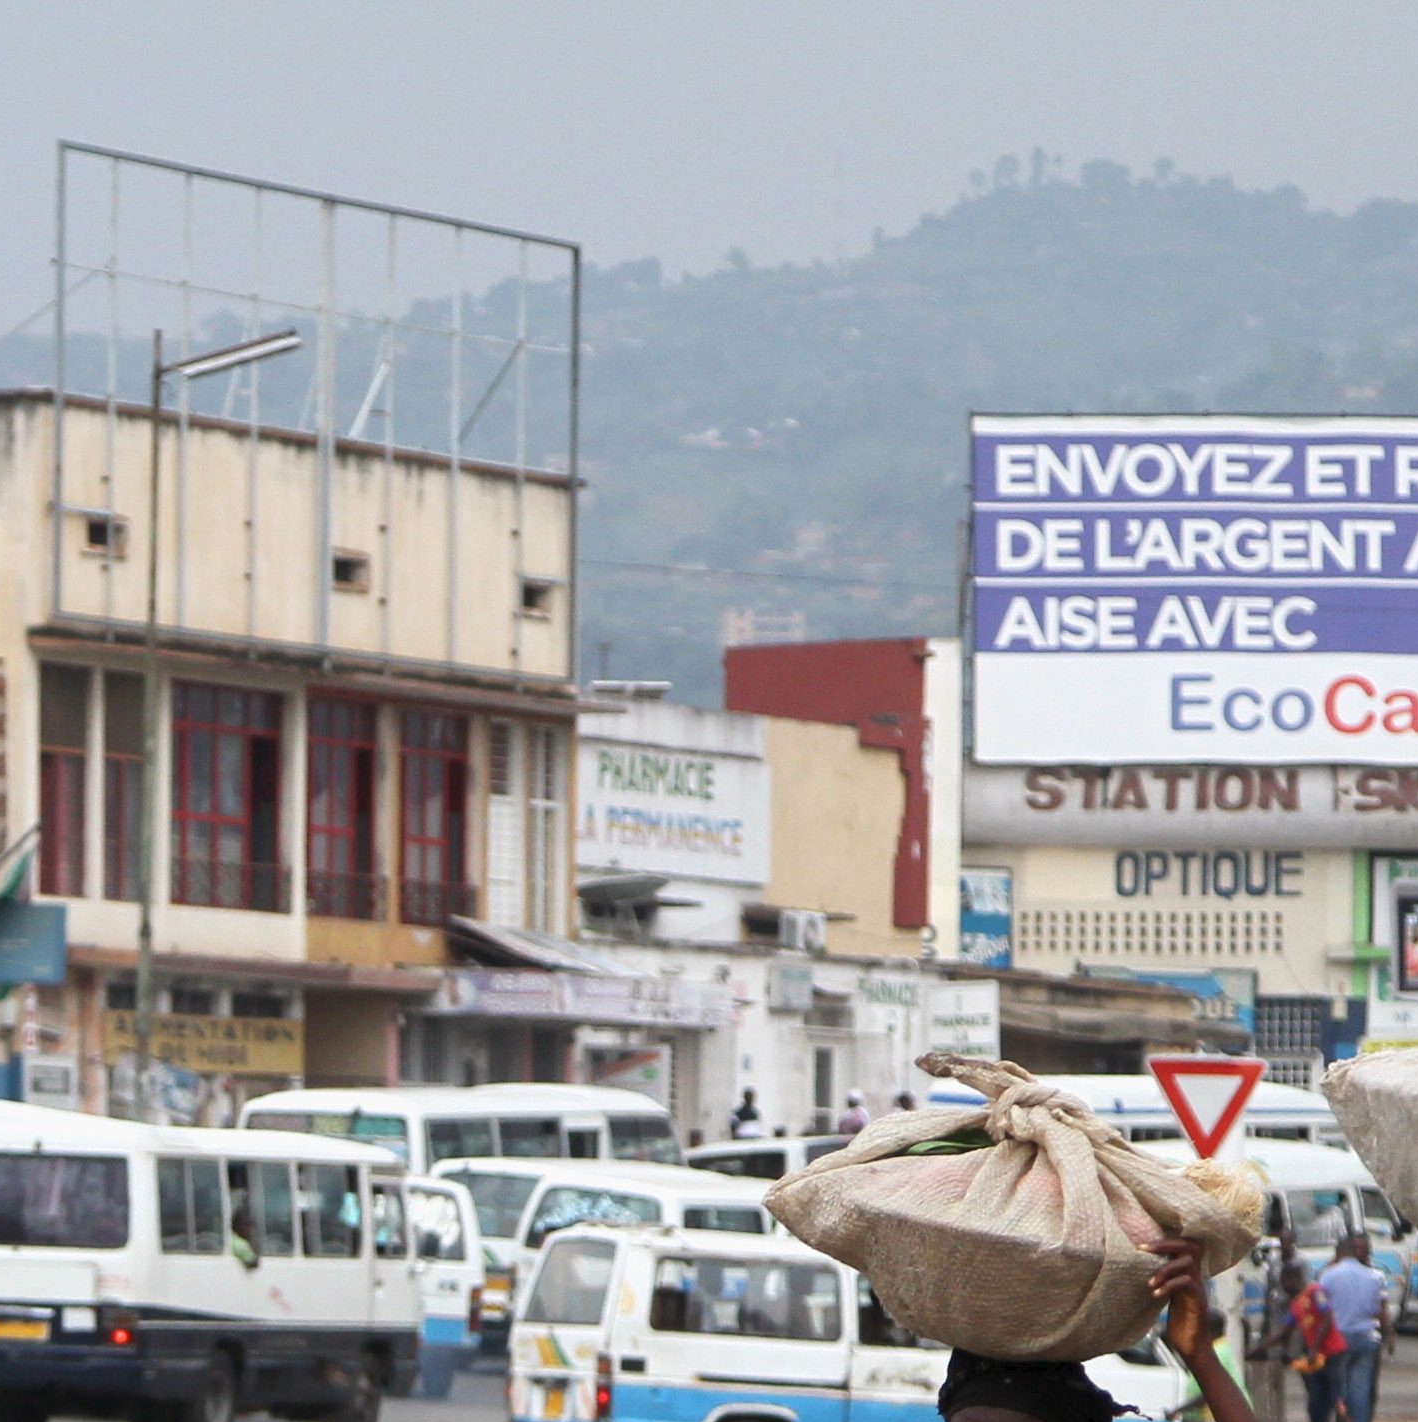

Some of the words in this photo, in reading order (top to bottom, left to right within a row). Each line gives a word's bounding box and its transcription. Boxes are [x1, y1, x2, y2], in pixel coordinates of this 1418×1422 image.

[995, 443, 1294, 497] ENVOYEZ
[1306, 444, 1384, 497] ET
[996, 518, 1084, 571] DE
[1095, 518, 1395, 572] L'ARGENT
[994, 596, 1138, 649] AISE
[1145, 595, 1318, 649] AVEC
[597, 751, 715, 800] PHARMACIE
[1025, 766, 1300, 811] STATION
[607, 805, 743, 856] PERMANENCE
[1115, 850, 1303, 899] OPTIQUE
[115, 1014, 295, 1042] AMENTATION
